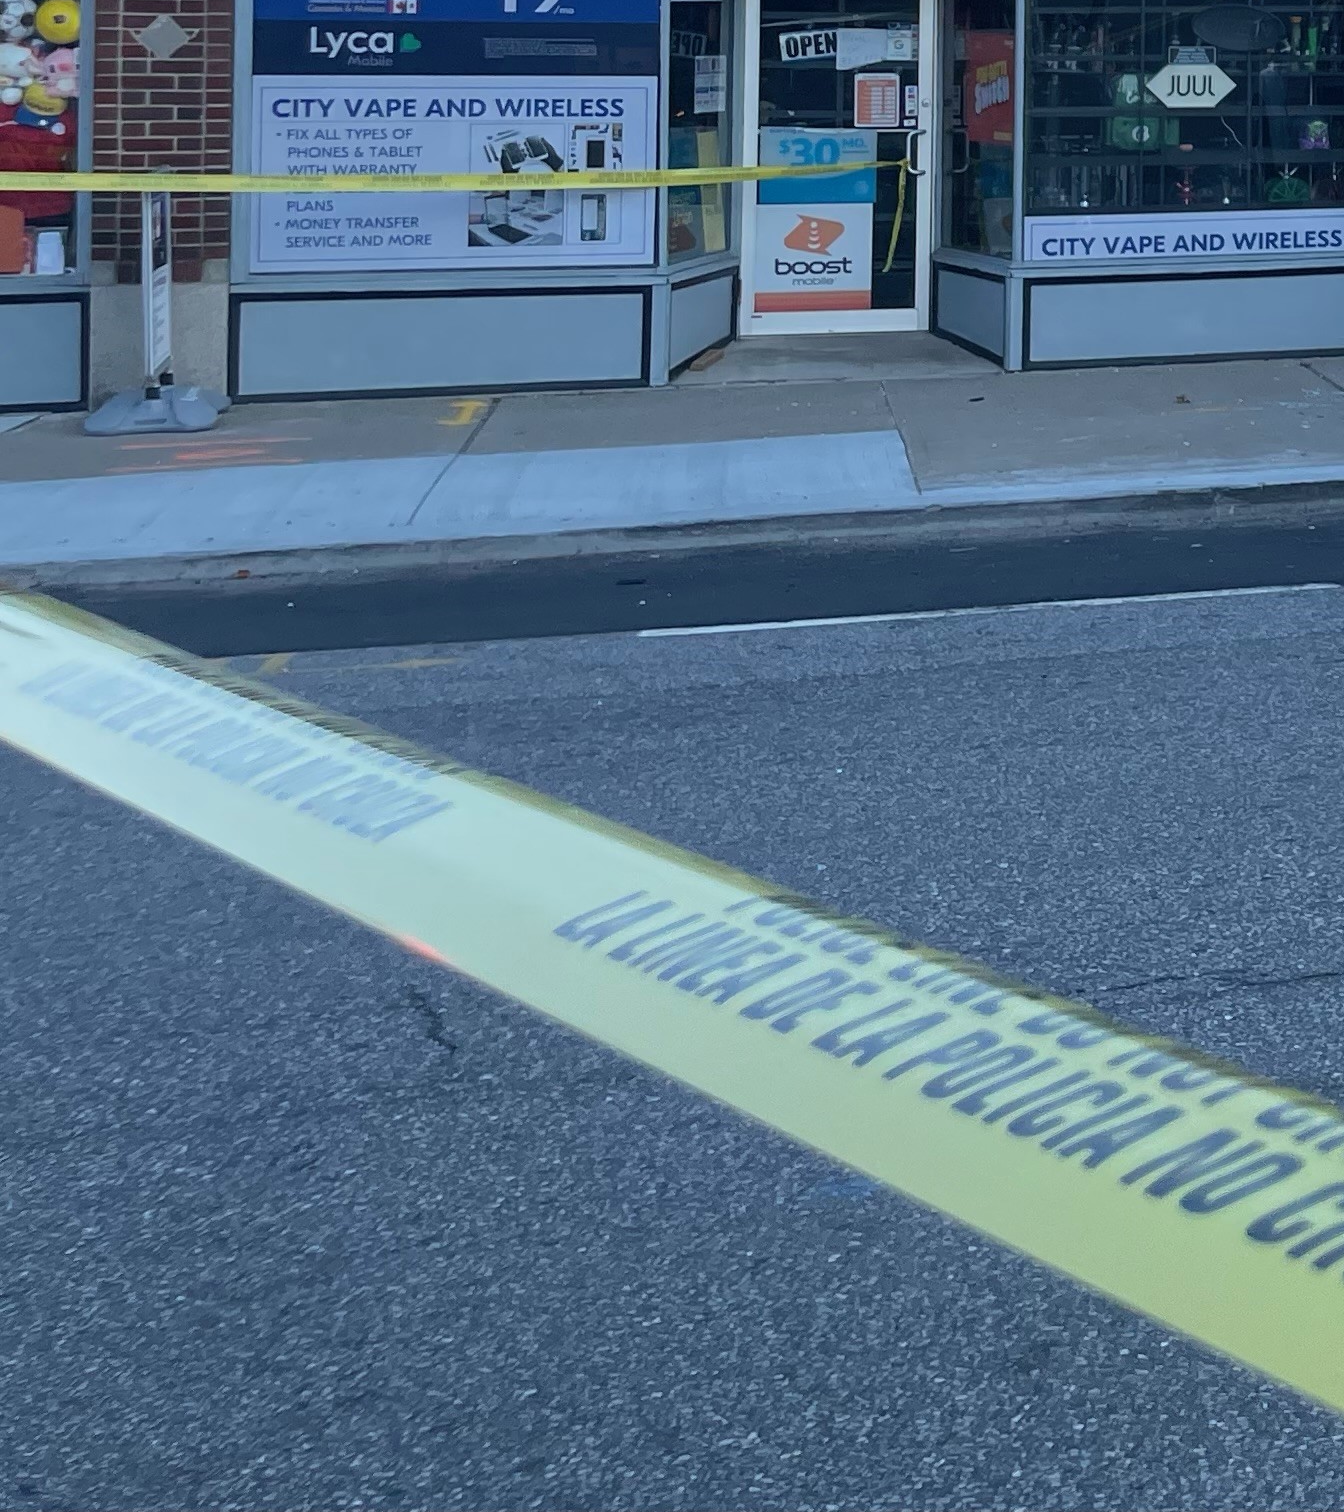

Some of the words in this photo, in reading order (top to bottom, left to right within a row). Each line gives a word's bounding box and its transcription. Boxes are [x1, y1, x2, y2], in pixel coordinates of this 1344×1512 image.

[310, 26, 394, 58] Lyca
[785, 31, 837, 58] OPEN
[271, 99, 335, 118] CITY
[344, 99, 417, 118] VAPE
[424, 98, 487, 118] AND
[495, 98, 625, 118] WIRELESS
[287, 128, 309, 140] FIX
[314, 129, 341, 140] ALL
[347, 128, 388, 140] TYPES
[392, 128, 413, 140] OF
[287, 146, 349, 158] PHONES
[354, 146, 364, 158] &
[369, 146, 423, 158] TABLET
[288, 164, 328, 176] WITH
[333, 163, 418, 175] WARRANTY
[286, 200, 334, 213] PLANS
[284, 217, 341, 230] MONEY
[346, 216, 420, 229] TRANSFER
[284, 235, 346, 248] SERVICE
[350, 235, 383, 248] AND
[387, 234, 433, 247] MORE
[1041, 237, 1097, 257] CITY
[1103, 234, 1166, 255] VAPE
[1173, 232, 1225, 253] AND
[1232, 229, 1343, 251] WIRELESS
[774, 256, 853, 276] boost
[792, 277, 835, 286] mobile
[810, 996, 952, 1067] LA
[882, 1027, 1185, 1170] POLICIA
[1119, 1127, 1303, 1214] NO
